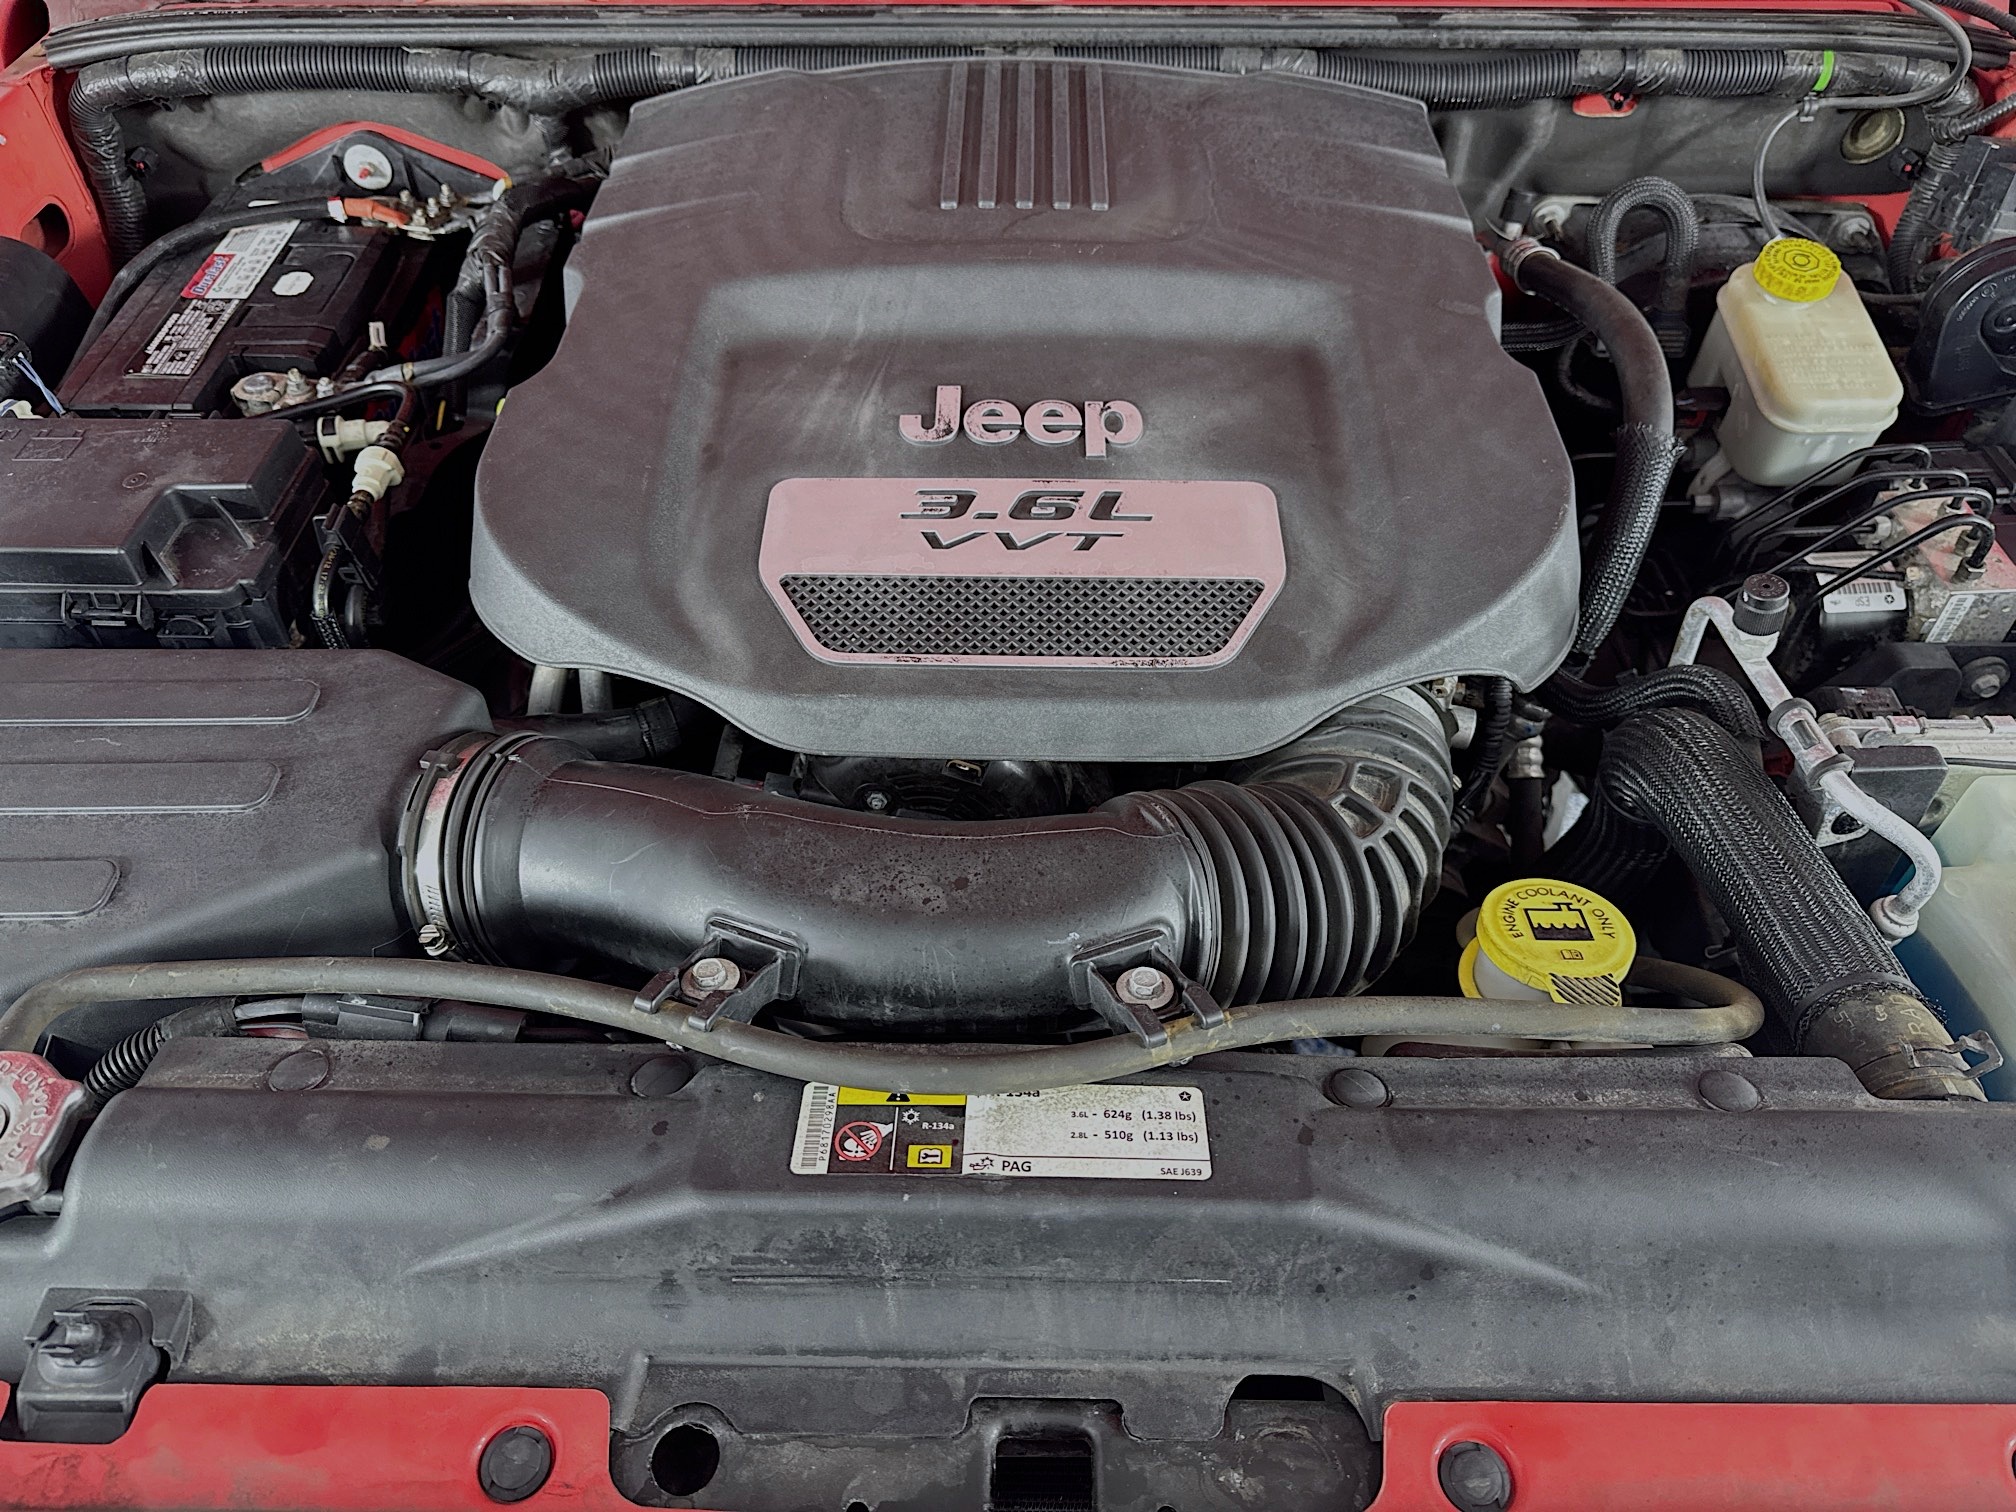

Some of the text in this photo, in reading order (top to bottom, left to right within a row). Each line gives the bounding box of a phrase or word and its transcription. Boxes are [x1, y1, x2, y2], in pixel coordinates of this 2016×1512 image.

[191, 255, 227, 295] Duralast
[899, 385, 1143, 459] Jeep
[899, 489, 1153, 521] 3.6L
[920, 530, 1125, 551] VVT
[1503, 887, 1616, 939] ENGINE COOLANT ONLY
[921, 1121, 955, 1131] R-134a
[1103, 1110, 1132, 1121] 624g
[1141, 1110, 1171, 1121] (1.38
[1175, 1111, 1196, 1122] lbs)
[818, 1092, 837, 1162] P68170298AA
[1104, 1130, 1133, 1142] 510g
[1143, 1131, 1173, 1142] (1.13
[1177, 1132, 1199, 1143] lbs)
[1001, 1160, 1032, 1172] PAG
[1160, 1167, 1202, 1177] SAE J639
